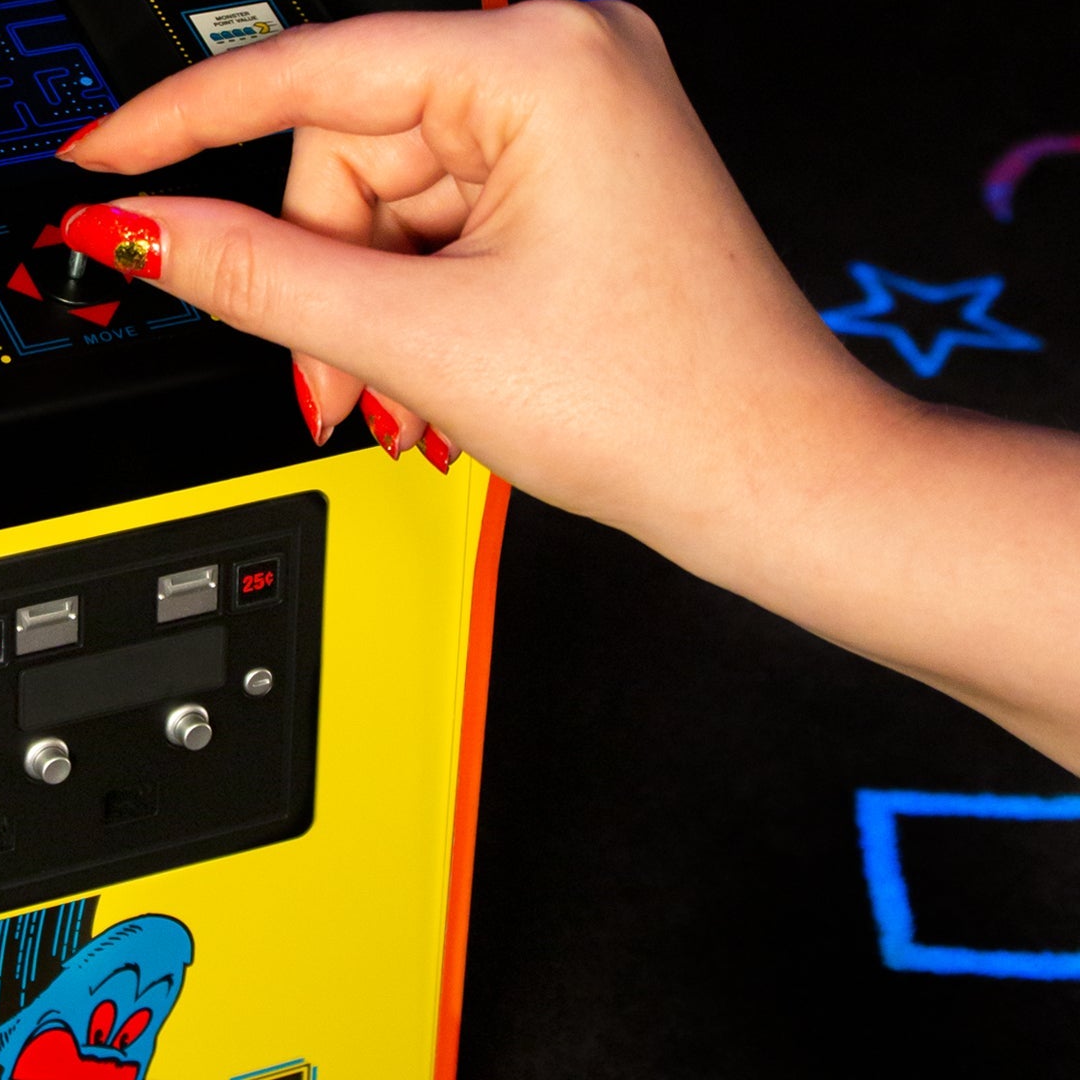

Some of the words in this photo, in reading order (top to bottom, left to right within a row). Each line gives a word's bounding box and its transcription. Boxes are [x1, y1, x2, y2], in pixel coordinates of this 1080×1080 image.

[213, 19, 235, 27] POINT
[215, 11, 251, 21] MONSTER
[83, 325, 139, 345] MOVE
[242, 570, 274, 593] 25¢
